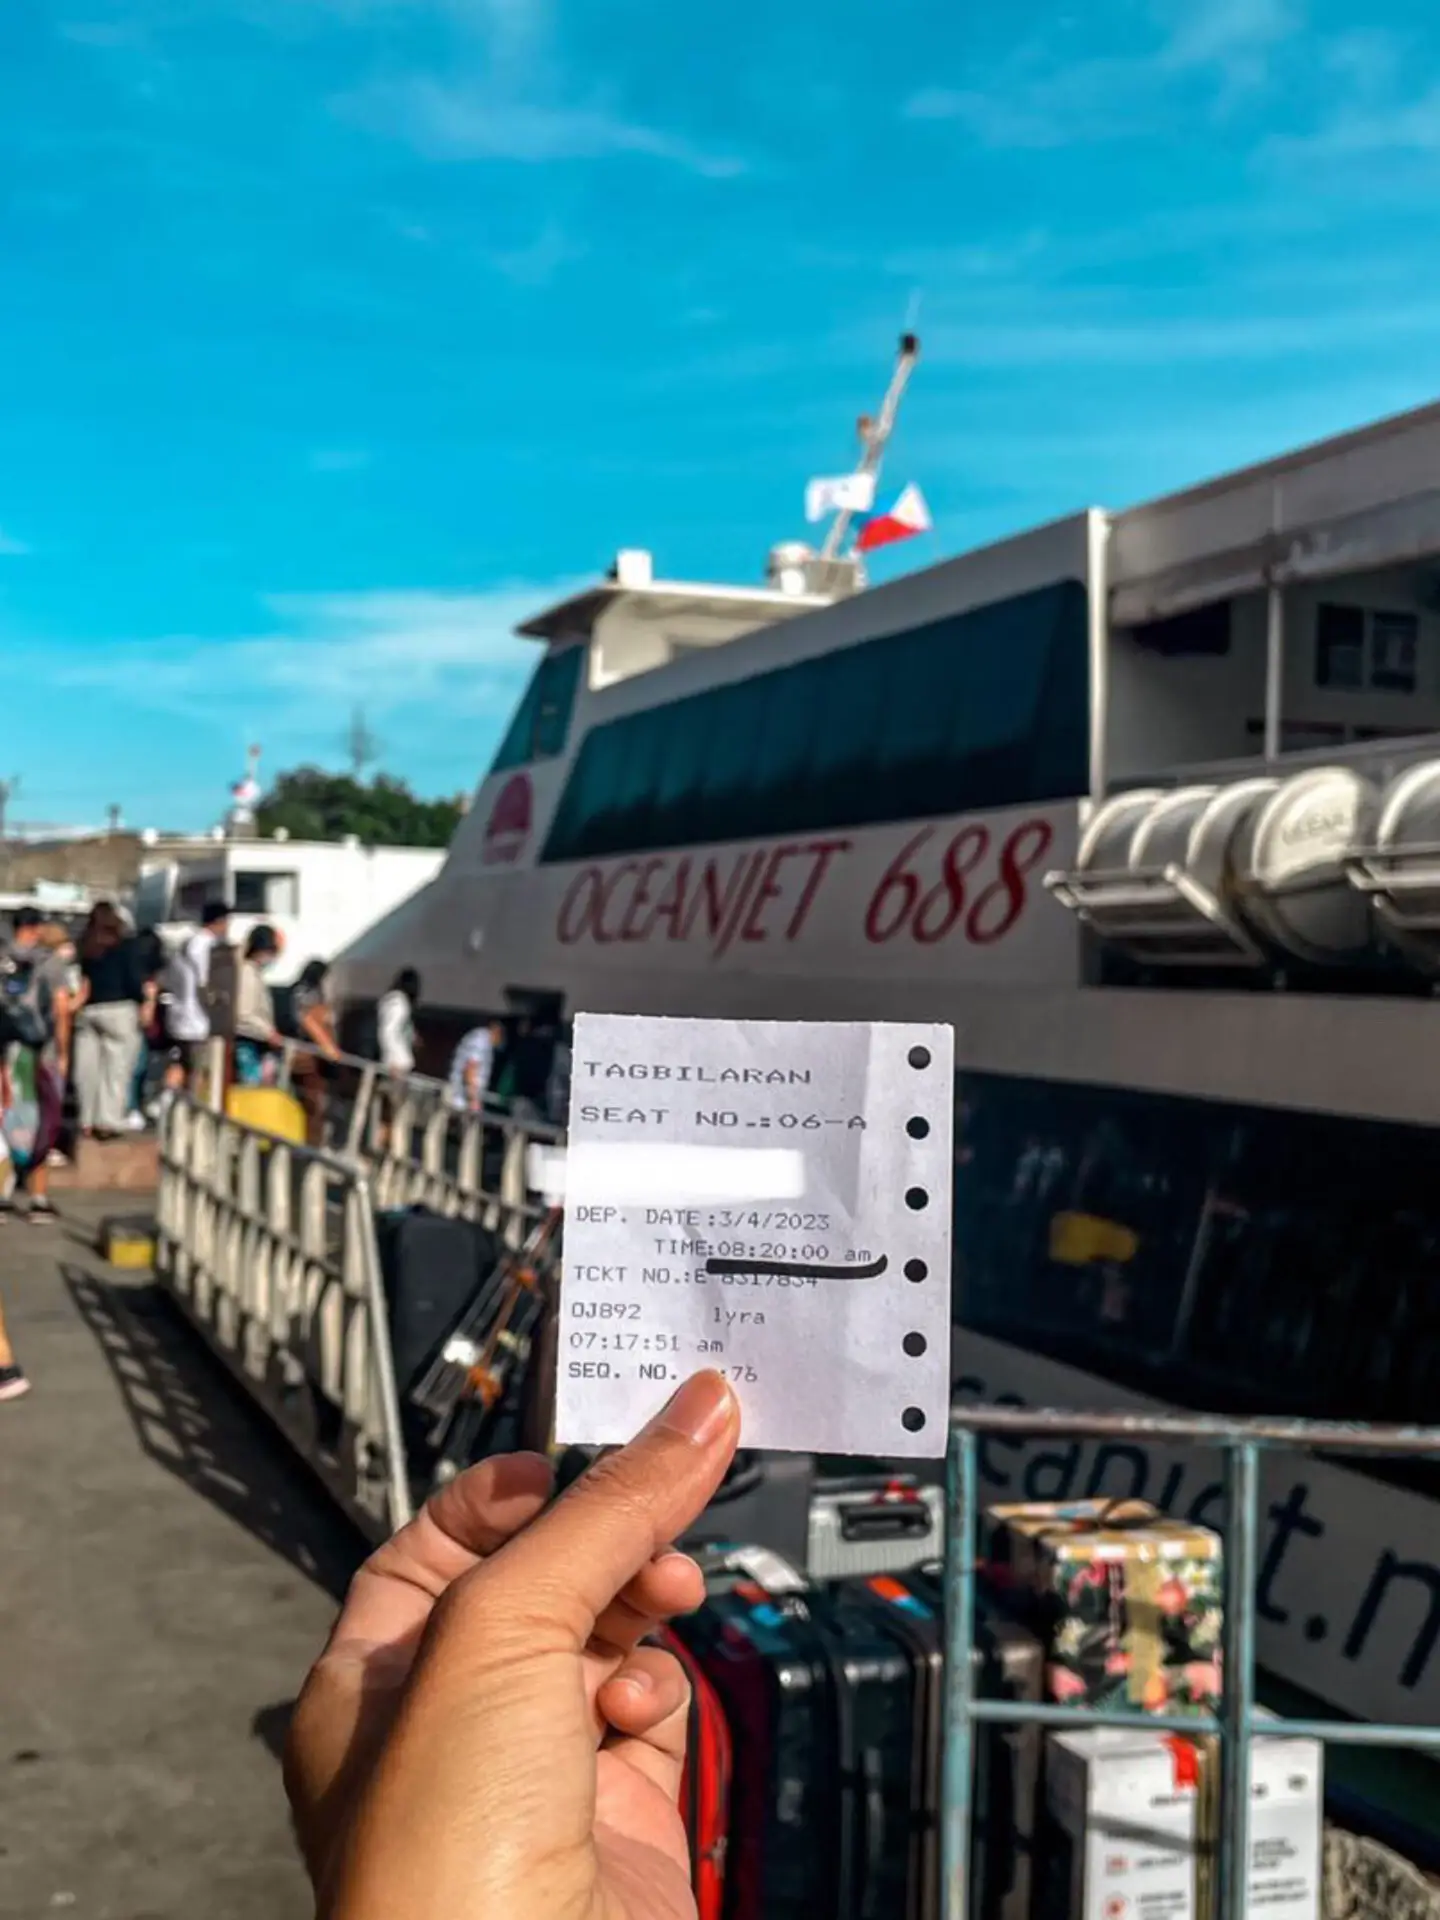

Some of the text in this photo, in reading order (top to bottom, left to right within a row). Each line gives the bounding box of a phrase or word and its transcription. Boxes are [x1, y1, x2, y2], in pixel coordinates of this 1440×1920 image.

[556, 818, 1054, 959] OCEANJET 688
[583, 1060, 812, 1085] TAGBILARAN
[580, 1106, 868, 1131] SEAT NO.:06-A
[575, 1205, 629, 1223] DEP.
[654, 1238, 872, 1262] TIME:08:20:00 am
[573, 1264, 628, 1283] TCKT
[713, 1306, 766, 1327] lyra
[569, 1332, 725, 1353] 07:17:51 am
[638, 1363, 678, 1381] NO.
